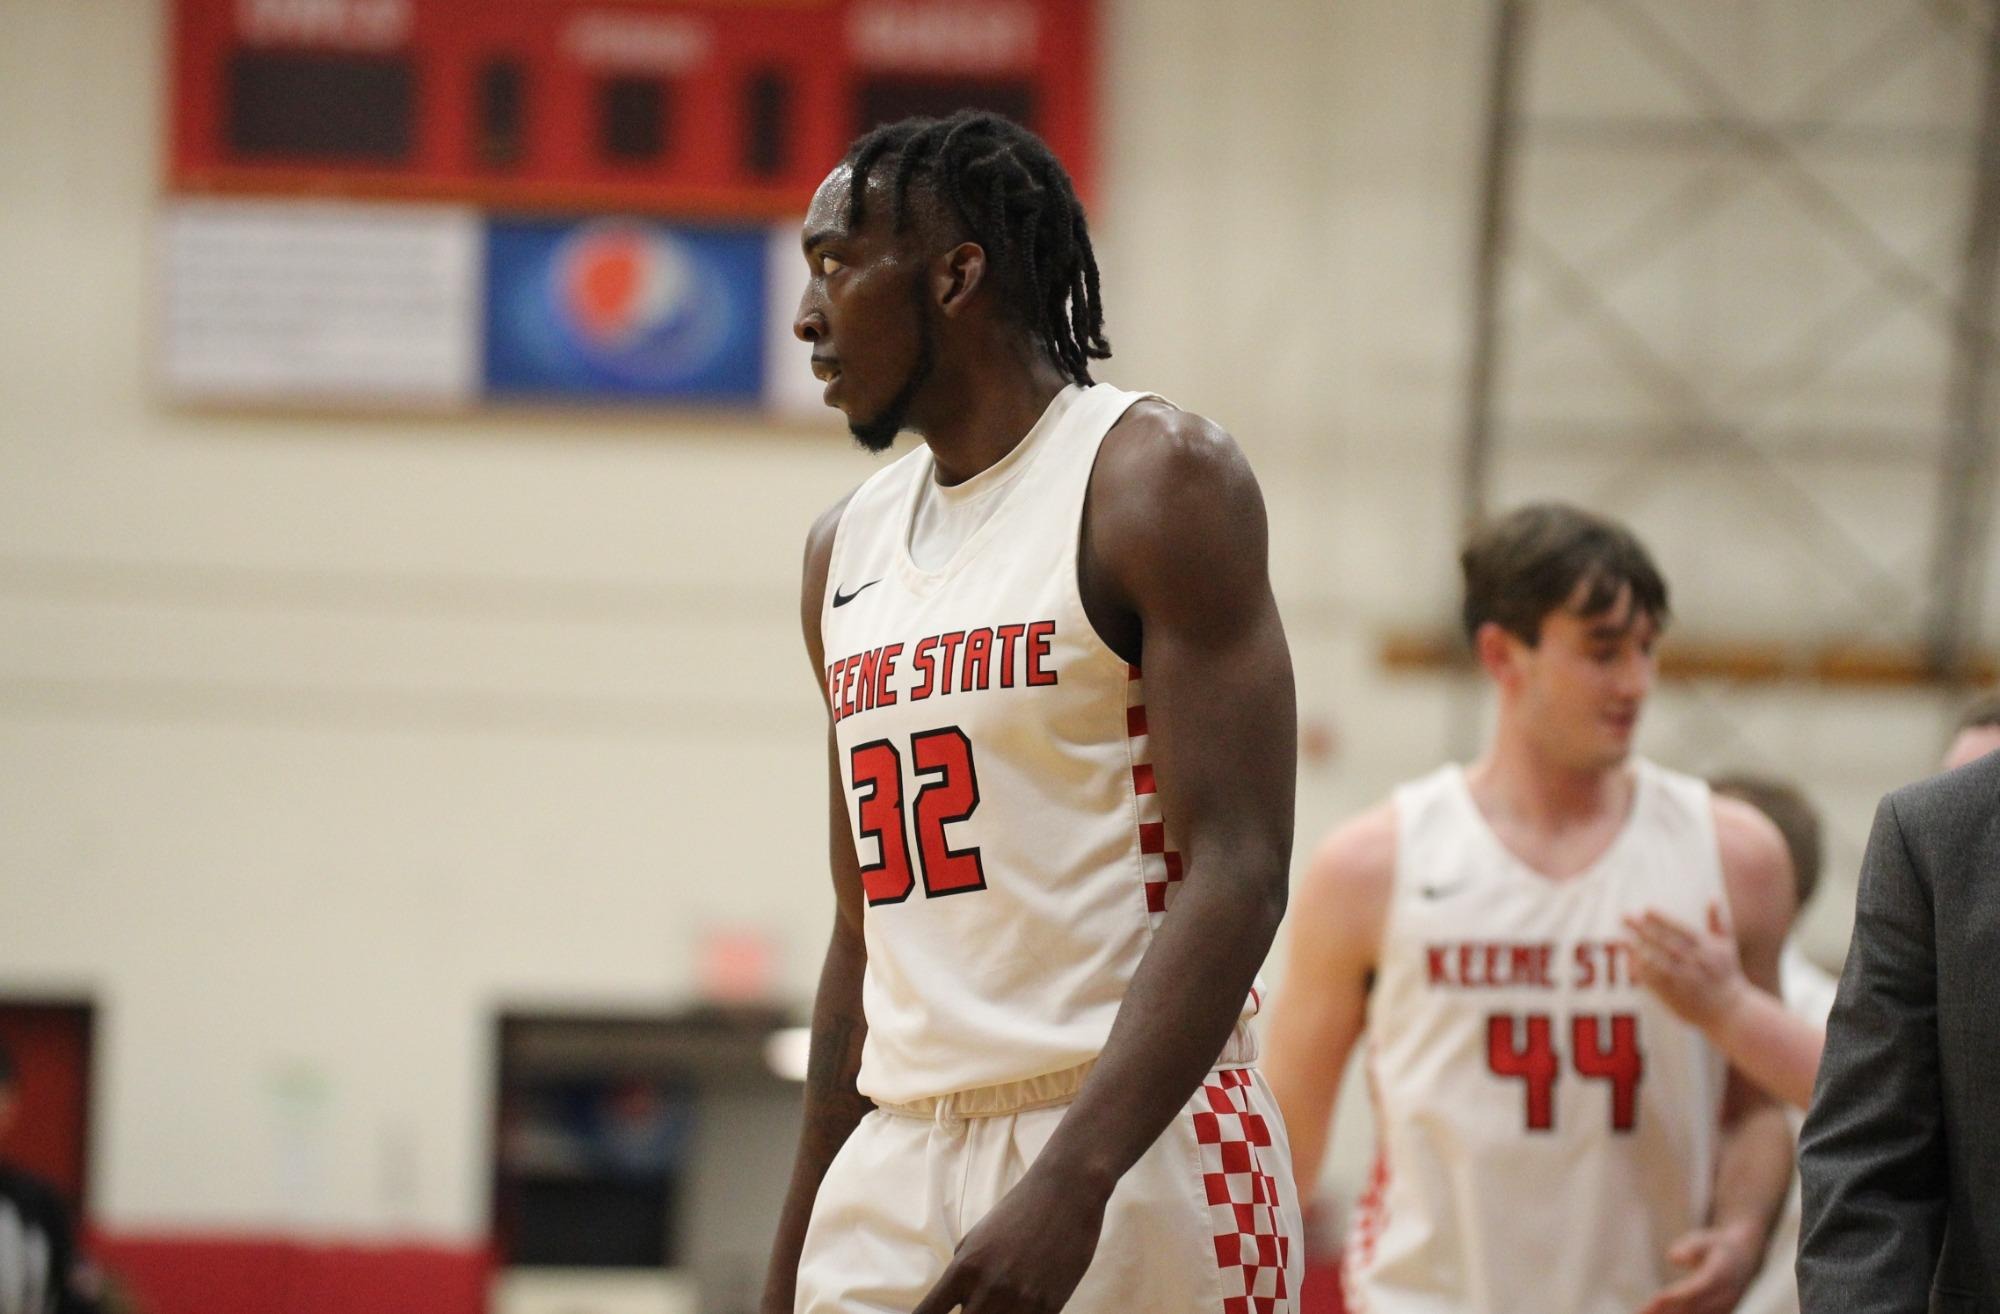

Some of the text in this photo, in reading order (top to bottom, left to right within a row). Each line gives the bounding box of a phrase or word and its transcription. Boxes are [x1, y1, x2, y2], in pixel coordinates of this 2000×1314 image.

[827, 620, 1058, 724] EENE STATE
[851, 725, 987, 907] 32
[1426, 942, 1553, 988] KEENE
[1487, 1012, 1643, 1132] 44
